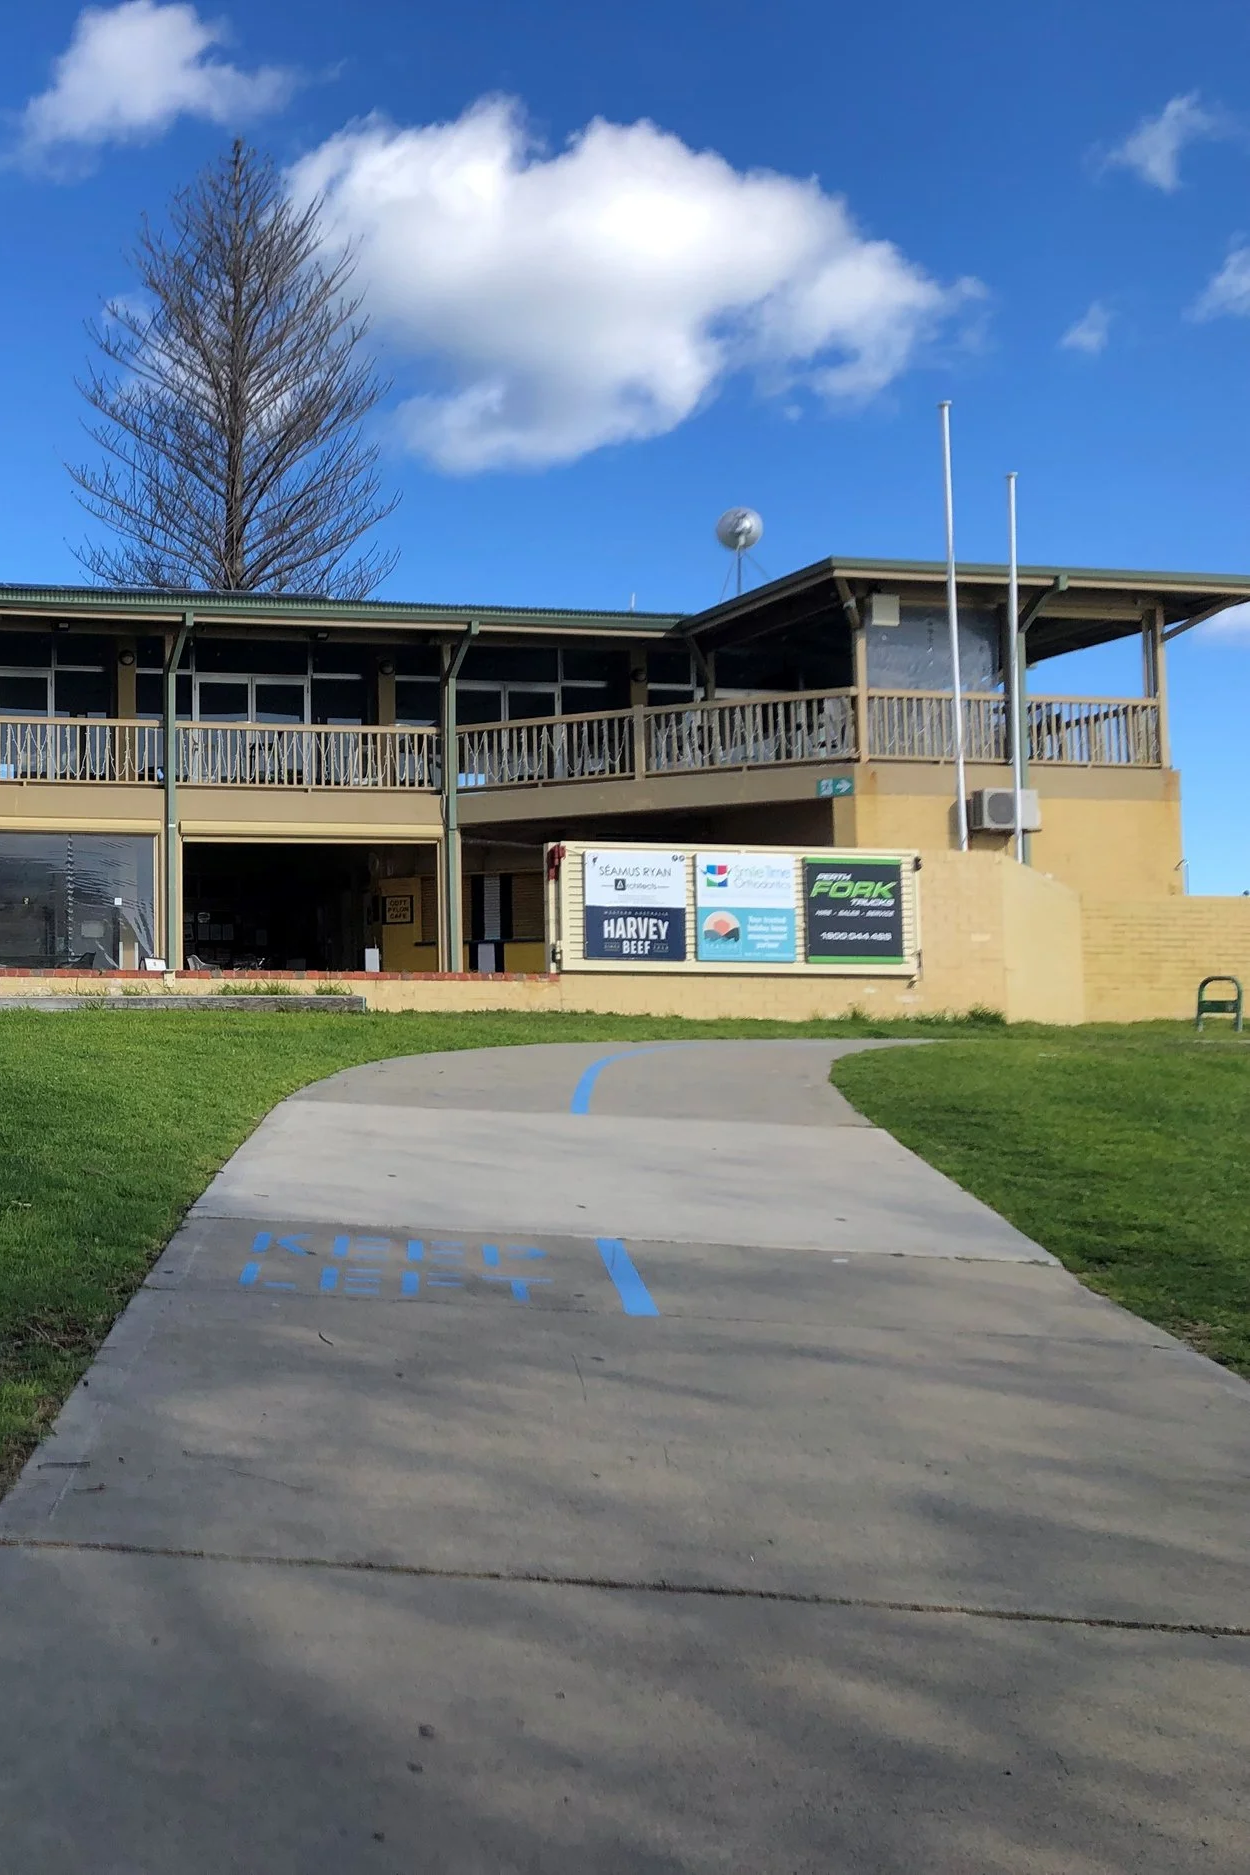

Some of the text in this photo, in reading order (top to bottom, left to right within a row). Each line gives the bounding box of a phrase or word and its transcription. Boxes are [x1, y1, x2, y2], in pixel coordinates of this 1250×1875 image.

[599, 864, 671, 877] SÉAMUS RYAN
[810, 880, 898, 898] FORK
[850, 898, 895, 906] TRUCKS
[603, 916, 669, 940] HARVEY
[622, 940, 651, 954] BEEF
[252, 1231, 548, 1267] KEEP
[238, 1262, 554, 1304] LEFT
